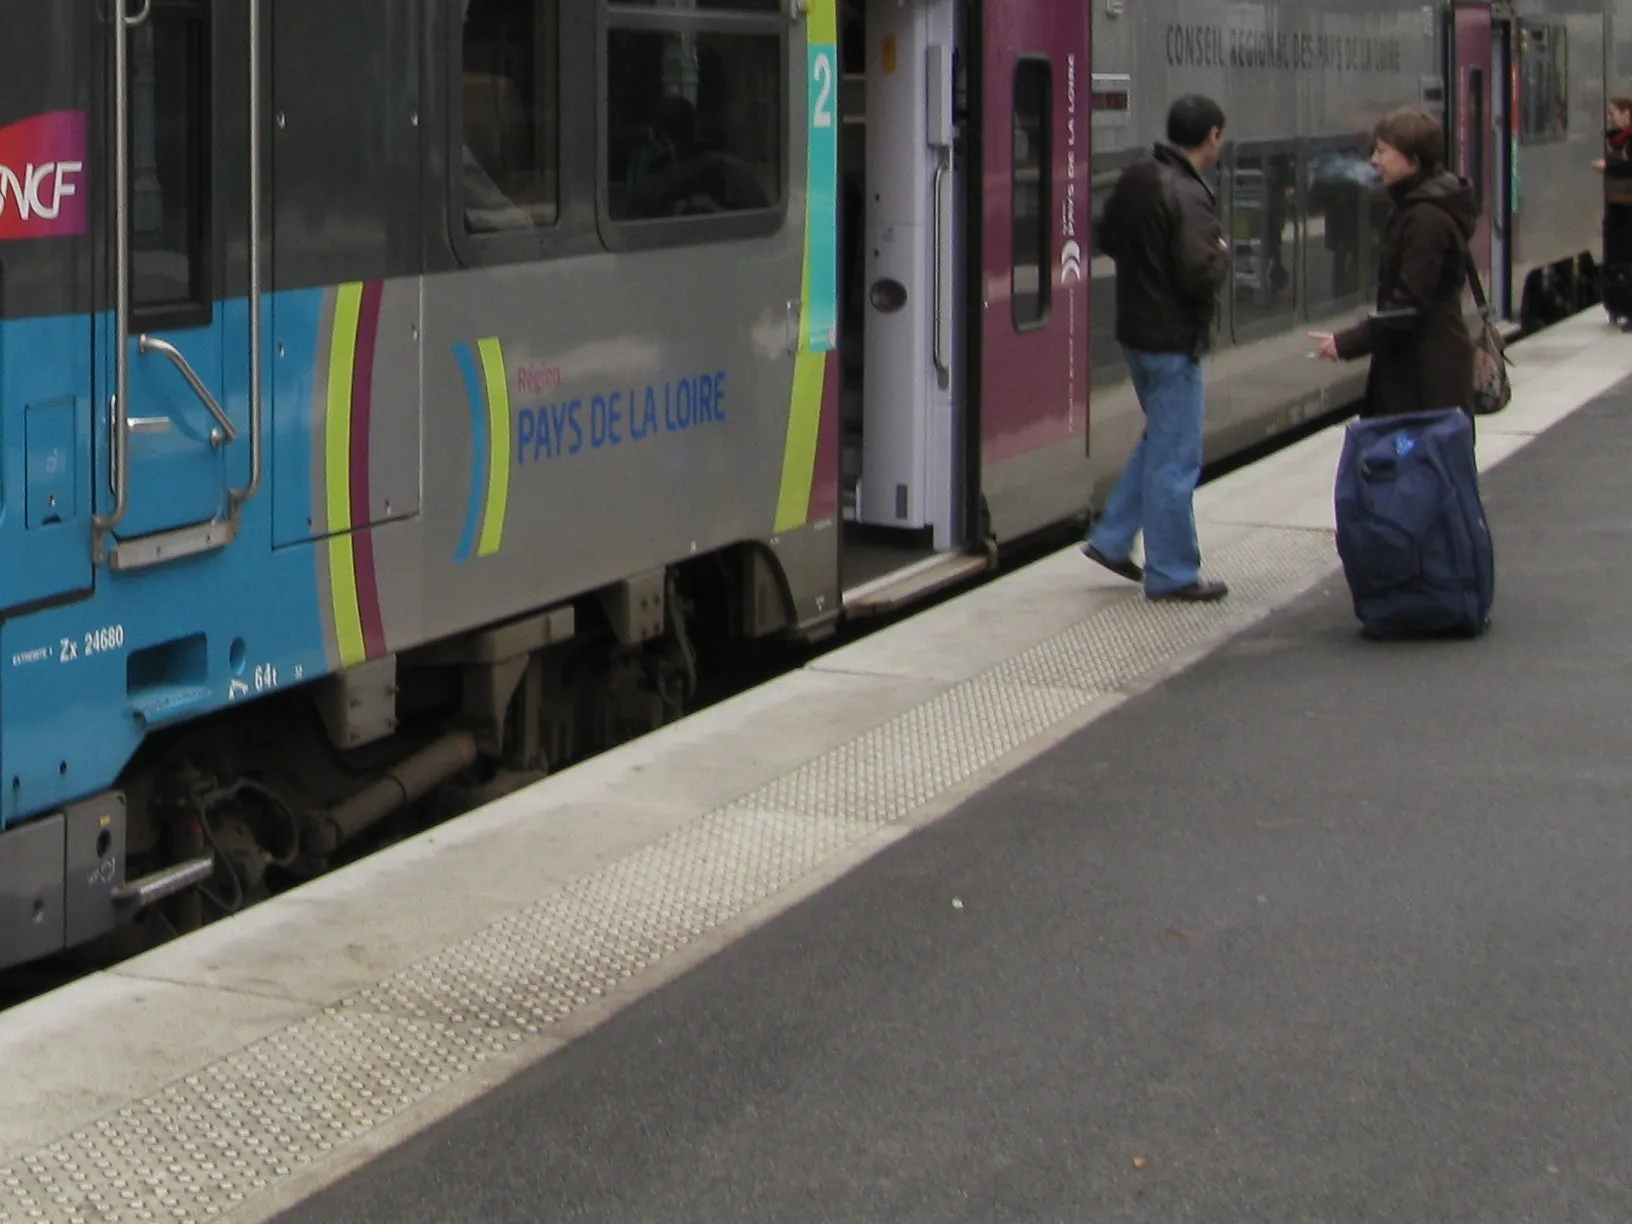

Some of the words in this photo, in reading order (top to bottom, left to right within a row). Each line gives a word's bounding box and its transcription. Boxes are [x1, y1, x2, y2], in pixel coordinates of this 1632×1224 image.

[1165, 24, 1225, 68] CONSEIL
[1293, 30, 1313, 70] DES
[813, 52, 832, 128] 2
[517, 397, 583, 466] PAYS
[590, 389, 623, 449] DE
[630, 383, 658, 442] LA
[665, 370, 727, 433] LOIRE
[84, 623, 125, 657] 24680
